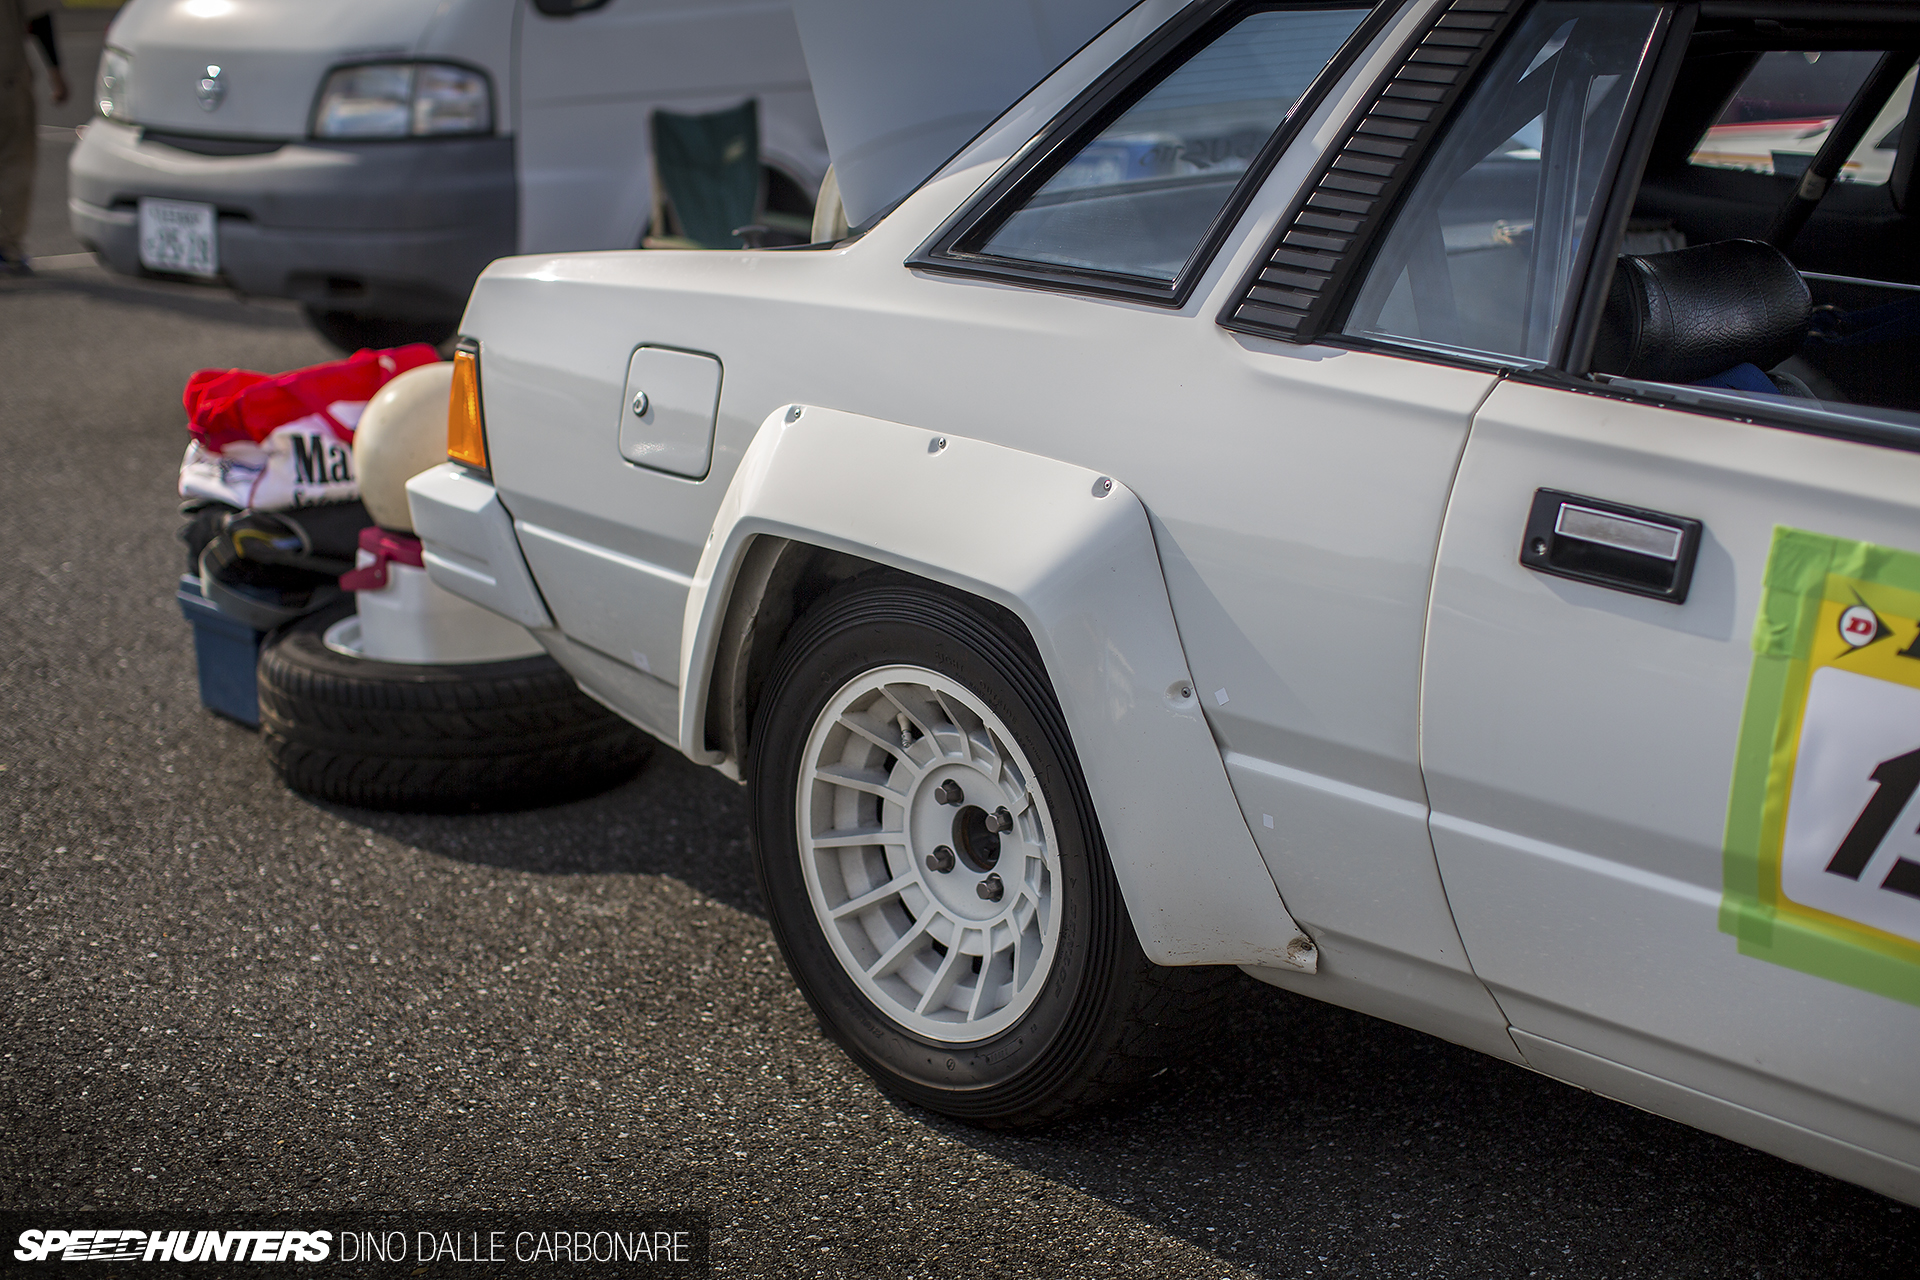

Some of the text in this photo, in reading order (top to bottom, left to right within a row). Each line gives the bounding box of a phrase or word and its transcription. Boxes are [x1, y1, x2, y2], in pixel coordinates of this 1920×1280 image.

[291, 433, 354, 484] Ma
[1845, 616, 1874, 637] D
[1824, 747, 1920, 902] 1
